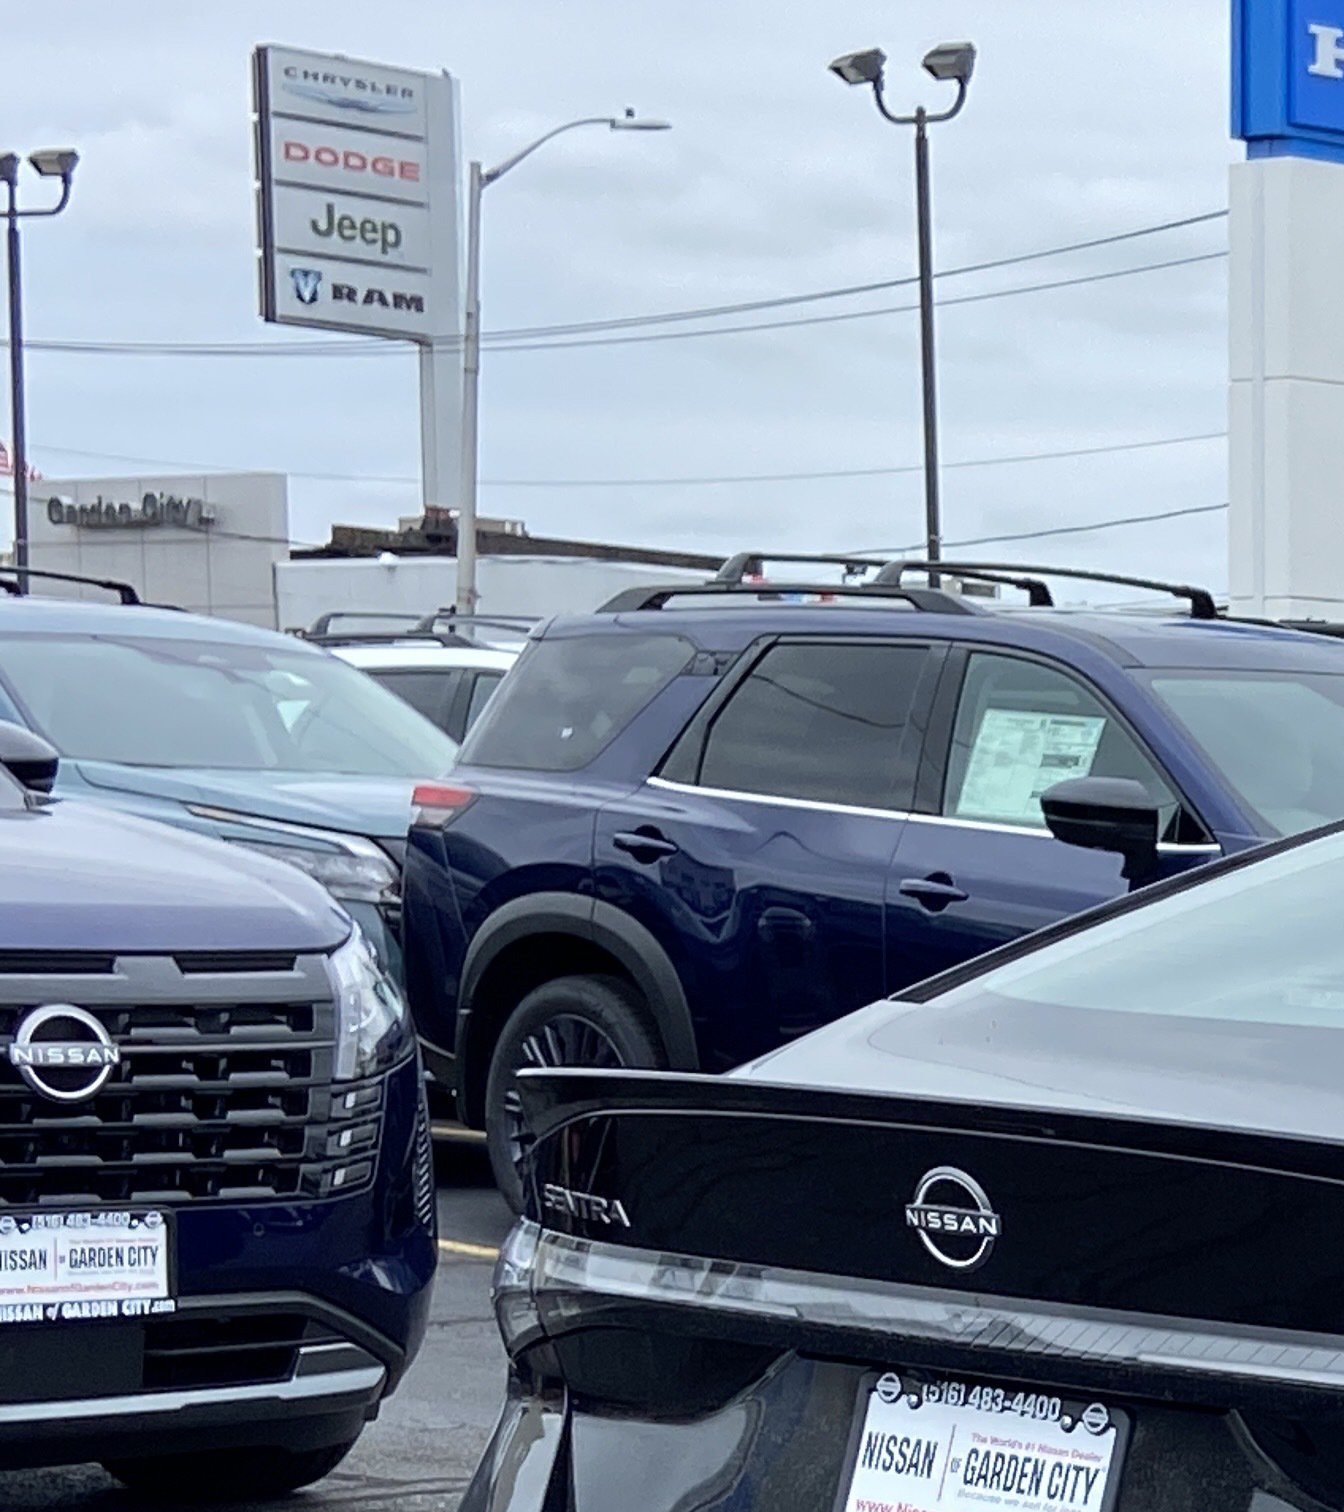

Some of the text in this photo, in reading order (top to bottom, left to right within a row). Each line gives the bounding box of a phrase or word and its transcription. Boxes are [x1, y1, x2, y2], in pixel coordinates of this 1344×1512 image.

[283, 66, 415, 99] CHRYSLER
[283, 141, 421, 182] DODGE
[310, 202, 402, 255] Jeep
[331, 282, 425, 314] RAM
[13, 1047, 120, 1063] NISSAN
[906, 1207, 1000, 1237] NISSAN
[69, 1247, 125, 1269] GARDEN
[127, 1245, 160, 1267] CITY
[61, 1301, 118, 1319] GARDEN
[921, 1380, 1063, 1423] (516) 483-4400
[971, 1432, 988, 1444] The
[861, 1431, 939, 1480] NISSAN
[963, 1447, 1047, 1498] GARDEN
[1047, 1460, 1101, 1506] CITY
